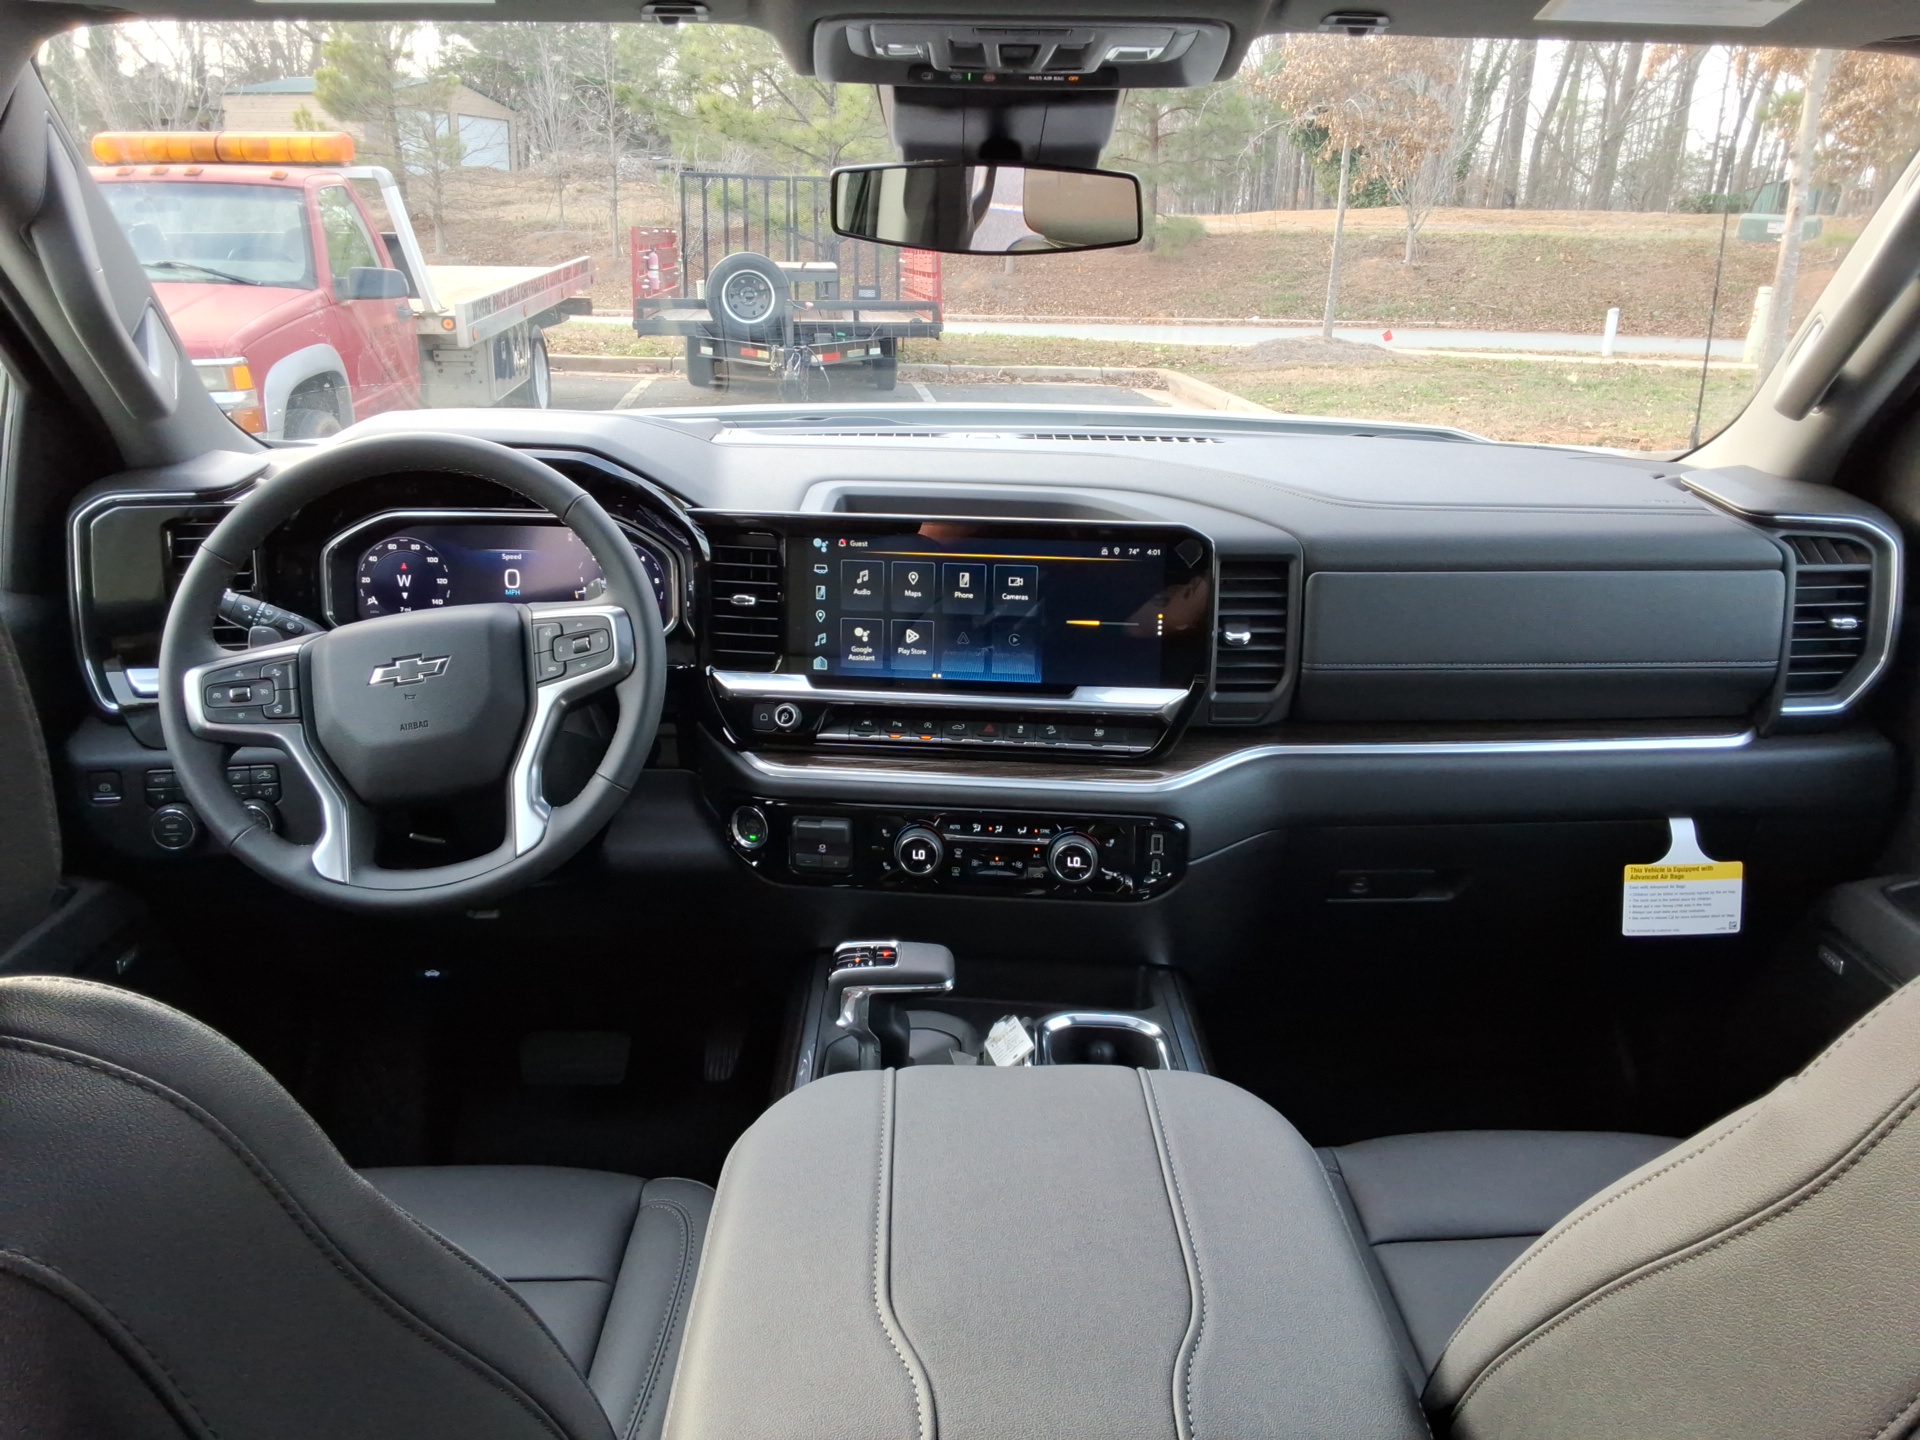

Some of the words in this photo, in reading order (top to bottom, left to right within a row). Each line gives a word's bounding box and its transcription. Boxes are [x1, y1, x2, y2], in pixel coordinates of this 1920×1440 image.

[387, 543, 398, 551] 60
[410, 543, 421, 551] 80
[368, 555, 378, 563] 40
[426, 556, 439, 564] 100
[396, 574, 412, 588] W
[904, 590, 922, 598] Maps
[954, 591, 974, 599] Phone
[1001, 593, 1029, 601] Cameras
[431, 598, 444, 606] 140
[851, 645, 873, 654] Google
[897, 647, 910, 656] Play
[400, 720, 429, 731] AIRBAG
